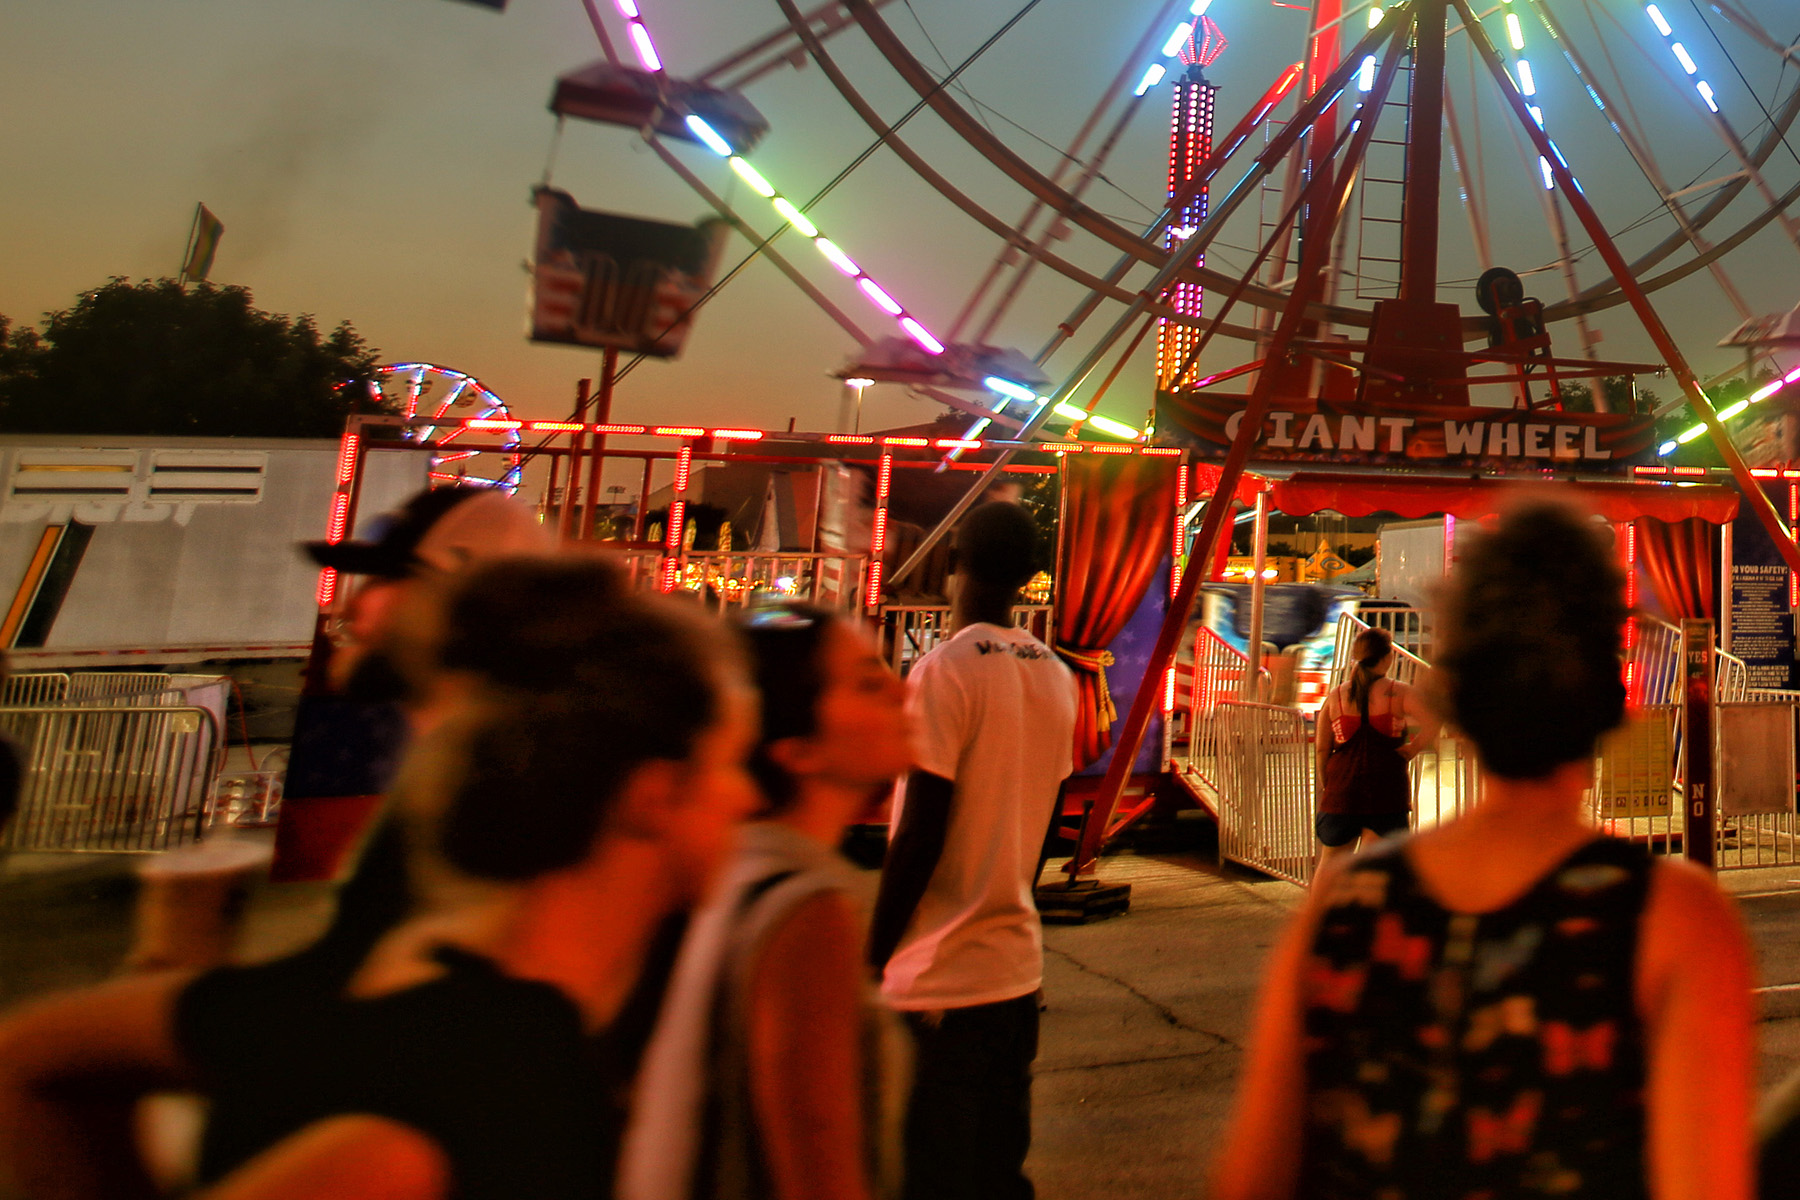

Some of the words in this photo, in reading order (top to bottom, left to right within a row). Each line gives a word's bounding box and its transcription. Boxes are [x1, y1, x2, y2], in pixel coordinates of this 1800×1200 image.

[1225, 410, 1415, 452] GIANT
[1444, 419, 1612, 460] WHEEL
[1740, 565, 1759, 574] YOUR
[1688, 650, 1708, 664] YES
[1692, 783, 1705, 818] NO
